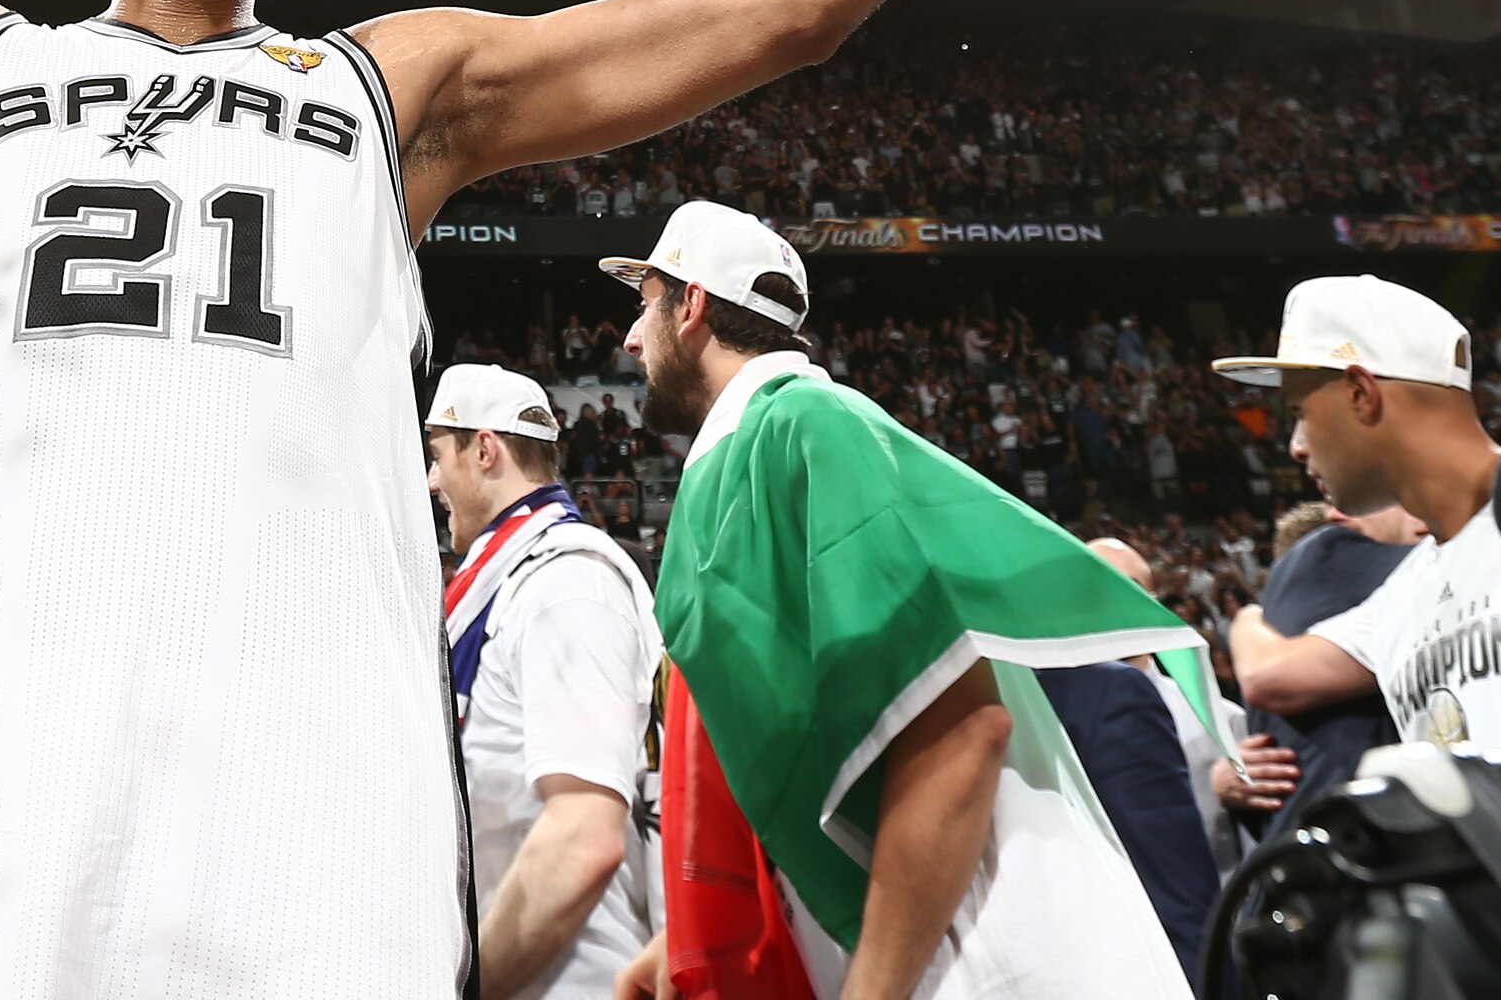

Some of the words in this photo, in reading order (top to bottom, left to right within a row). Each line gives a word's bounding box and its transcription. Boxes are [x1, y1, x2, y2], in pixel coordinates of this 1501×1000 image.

[426, 225, 517, 243] PION
[917, 222, 1104, 243] CHAMPION
[13, 177, 295, 360] 21
